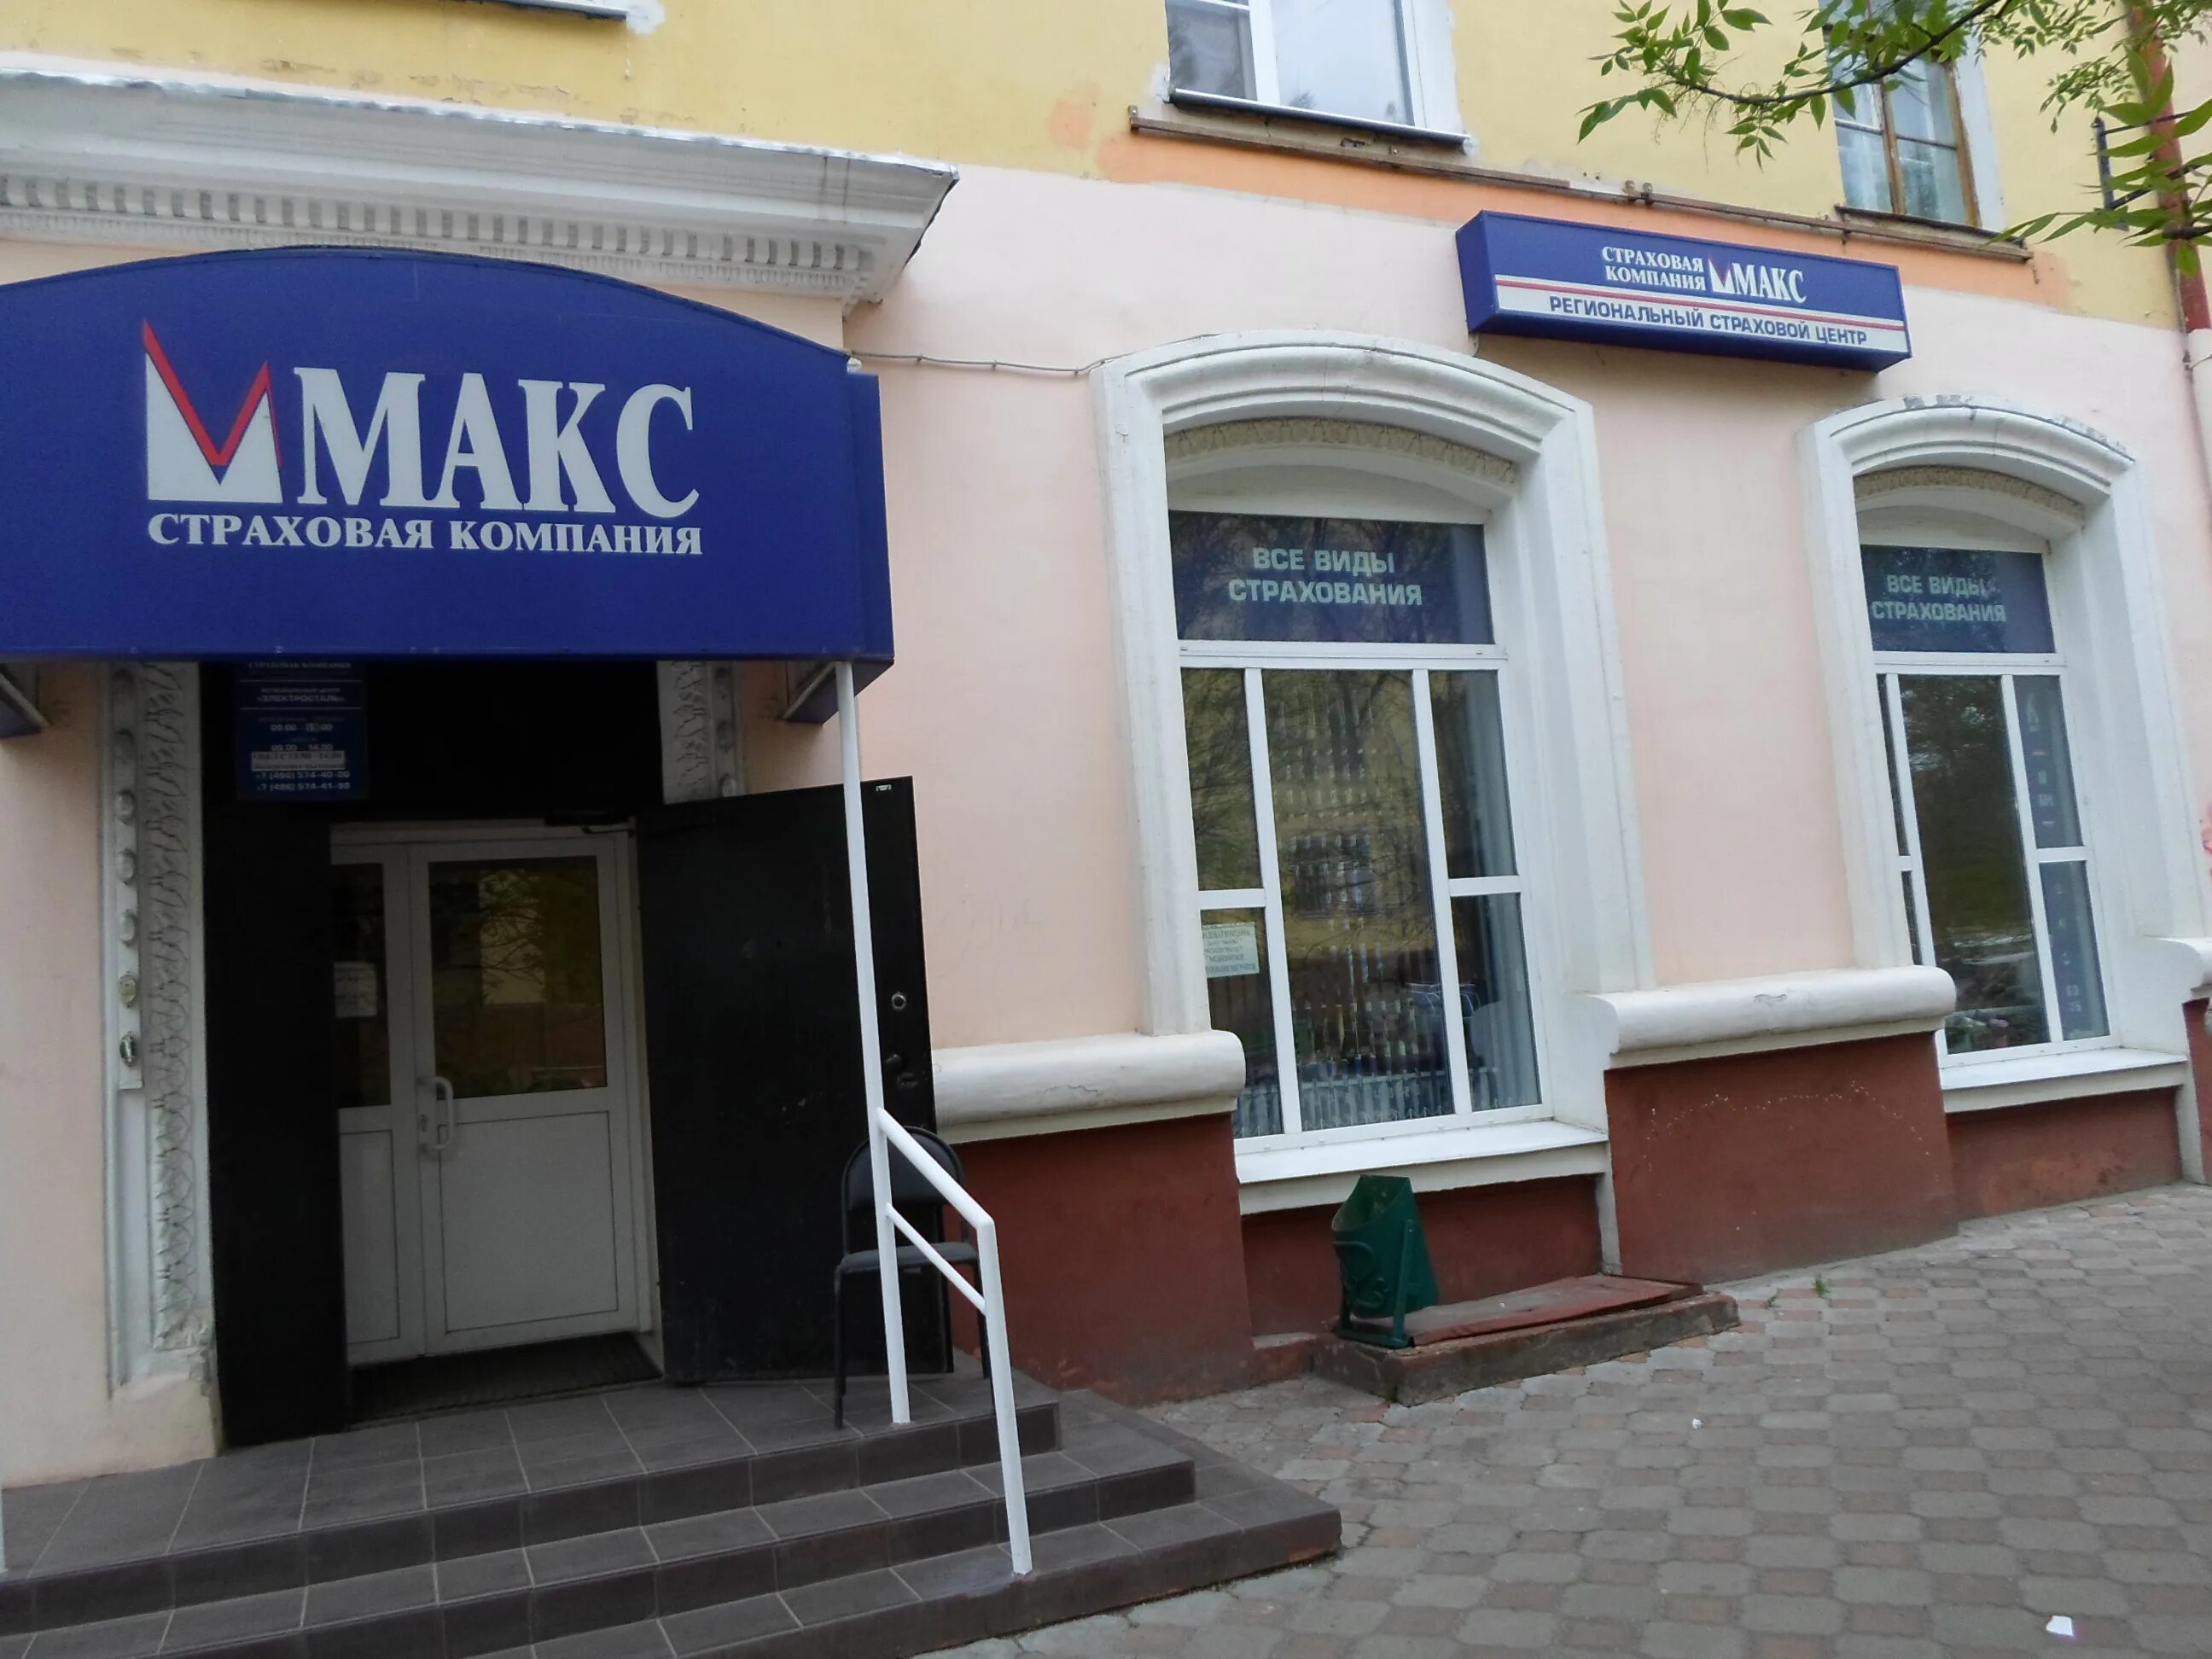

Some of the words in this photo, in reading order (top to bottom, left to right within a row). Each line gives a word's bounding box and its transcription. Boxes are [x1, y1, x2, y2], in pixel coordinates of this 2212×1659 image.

[1601, 246, 1705, 272] СТРАХОВАЯ
[1604, 266, 1707, 291] КОМПАНИЯ
[1731, 261, 1807, 305] МАКС
[1549, 295, 1705, 328] РЕГИОНАЛЬНЫЙ
[1709, 311, 1809, 340] СТРАХОВОЙ
[1814, 324, 1868, 346] ЦЕНТР
[293, 367, 700, 519] МАКС
[148, 513, 434, 550] СТРАХОВАЯ
[450, 521, 702, 556] КОМПАНИЯ
[1252, 547, 1306, 571] ВСЕ
[1314, 550, 1395, 578] ВИДЫ
[1228, 579, 1423, 607] СТРАХОВАНИЯ
[1886, 573, 1924, 594] ВСЕ
[1928, 576, 1988, 599] ВИДЫ
[1871, 600, 2007, 623] СТРАХОВАНИЯ
